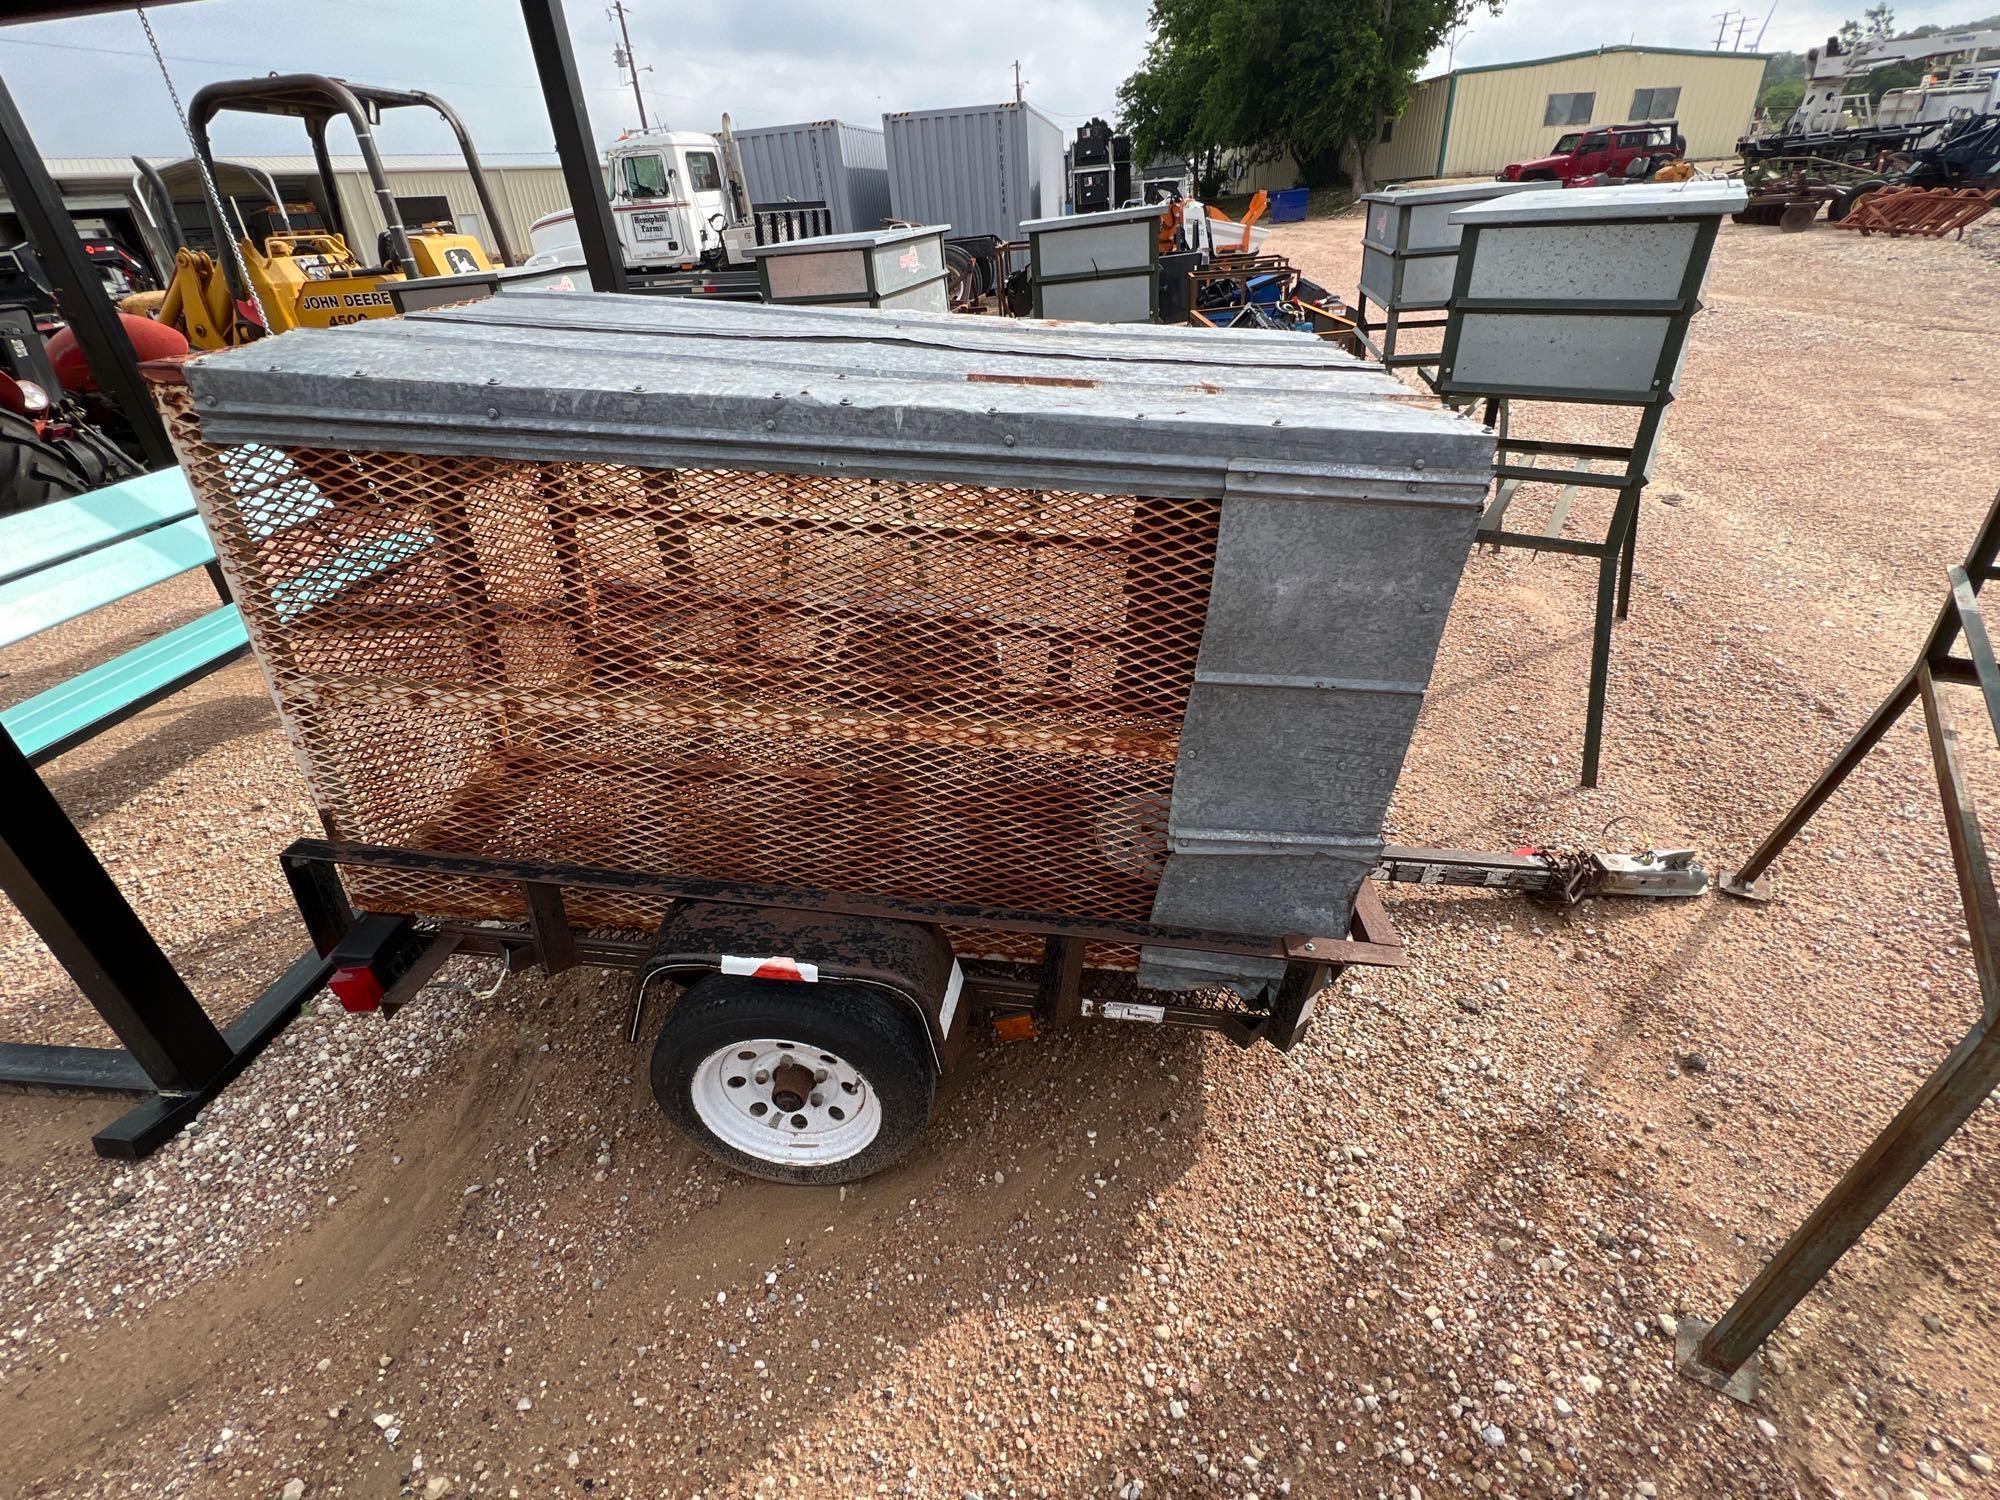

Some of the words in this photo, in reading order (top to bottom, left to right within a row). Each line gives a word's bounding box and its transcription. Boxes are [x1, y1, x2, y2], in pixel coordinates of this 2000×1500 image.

[634, 214, 667, 225] Hemphill
[641, 225, 664, 233] Farms
[304, 295, 340, 310] JOHN
[343, 292, 392, 307] DEERE
